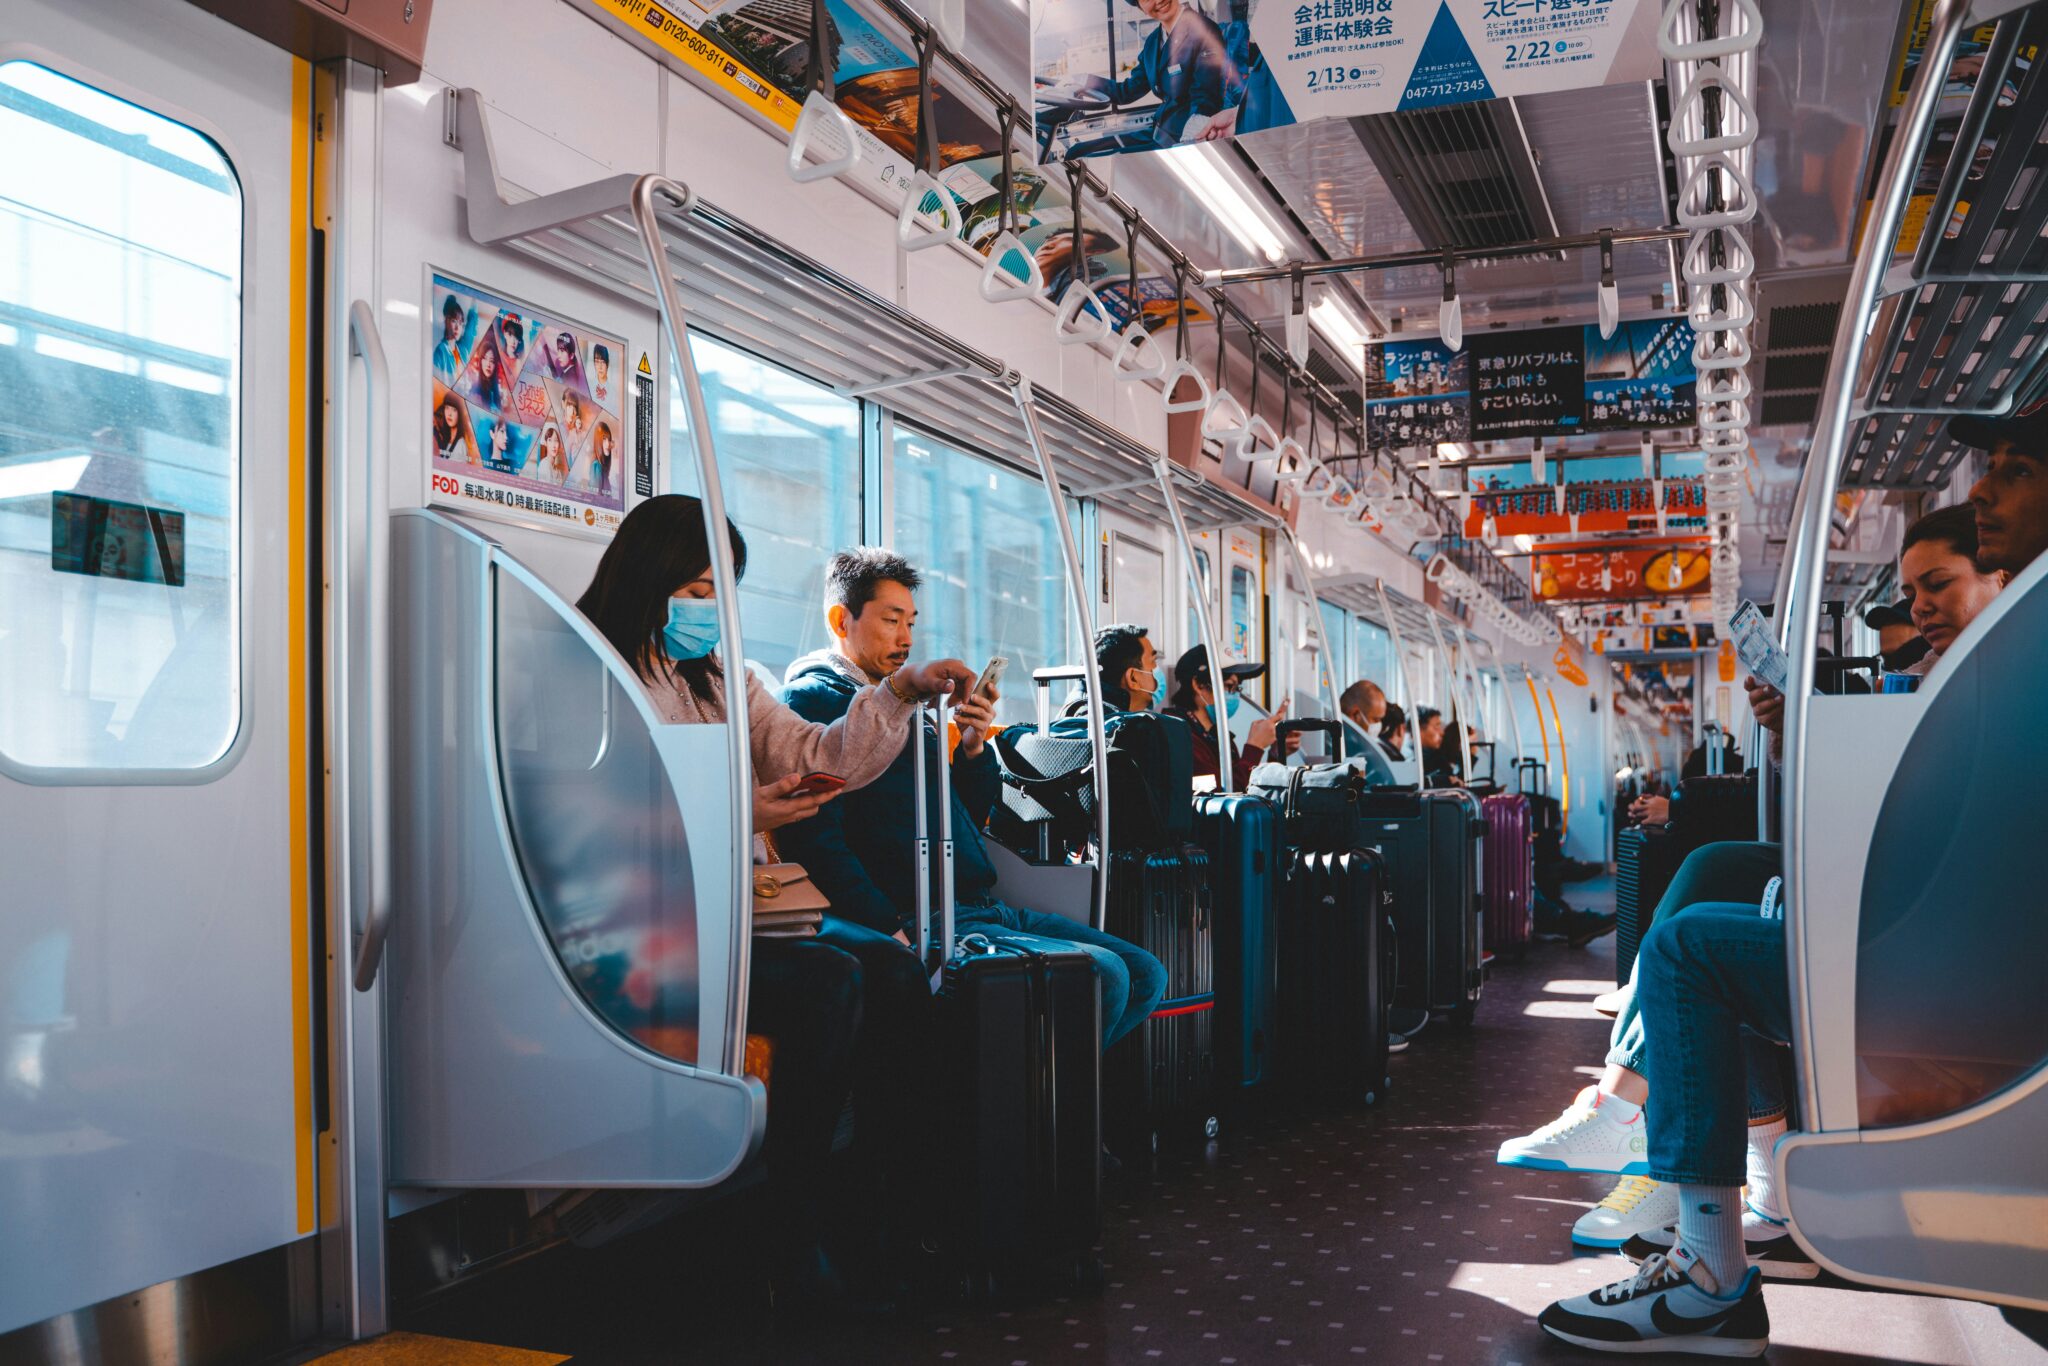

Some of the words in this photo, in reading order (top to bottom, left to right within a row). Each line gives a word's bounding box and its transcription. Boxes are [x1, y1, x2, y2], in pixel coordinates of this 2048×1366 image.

[1294, 0, 1393, 25] 会社説明&
[1483, 0, 1613, 19] スピード選
[1294, 15, 1393, 47] 運転体験会
[663, 19, 725, 68] 0120-600-811
[1505, 41, 1551, 62] 2/22
[1307, 66, 1345, 88] 2/13
[1406, 79, 1485, 100] 047-712-7345
[1478, 351, 1579, 371] 東急リバブルは、
[1479, 373, 1547, 391] 法人向けも
[432, 474, 459, 496] FOD
